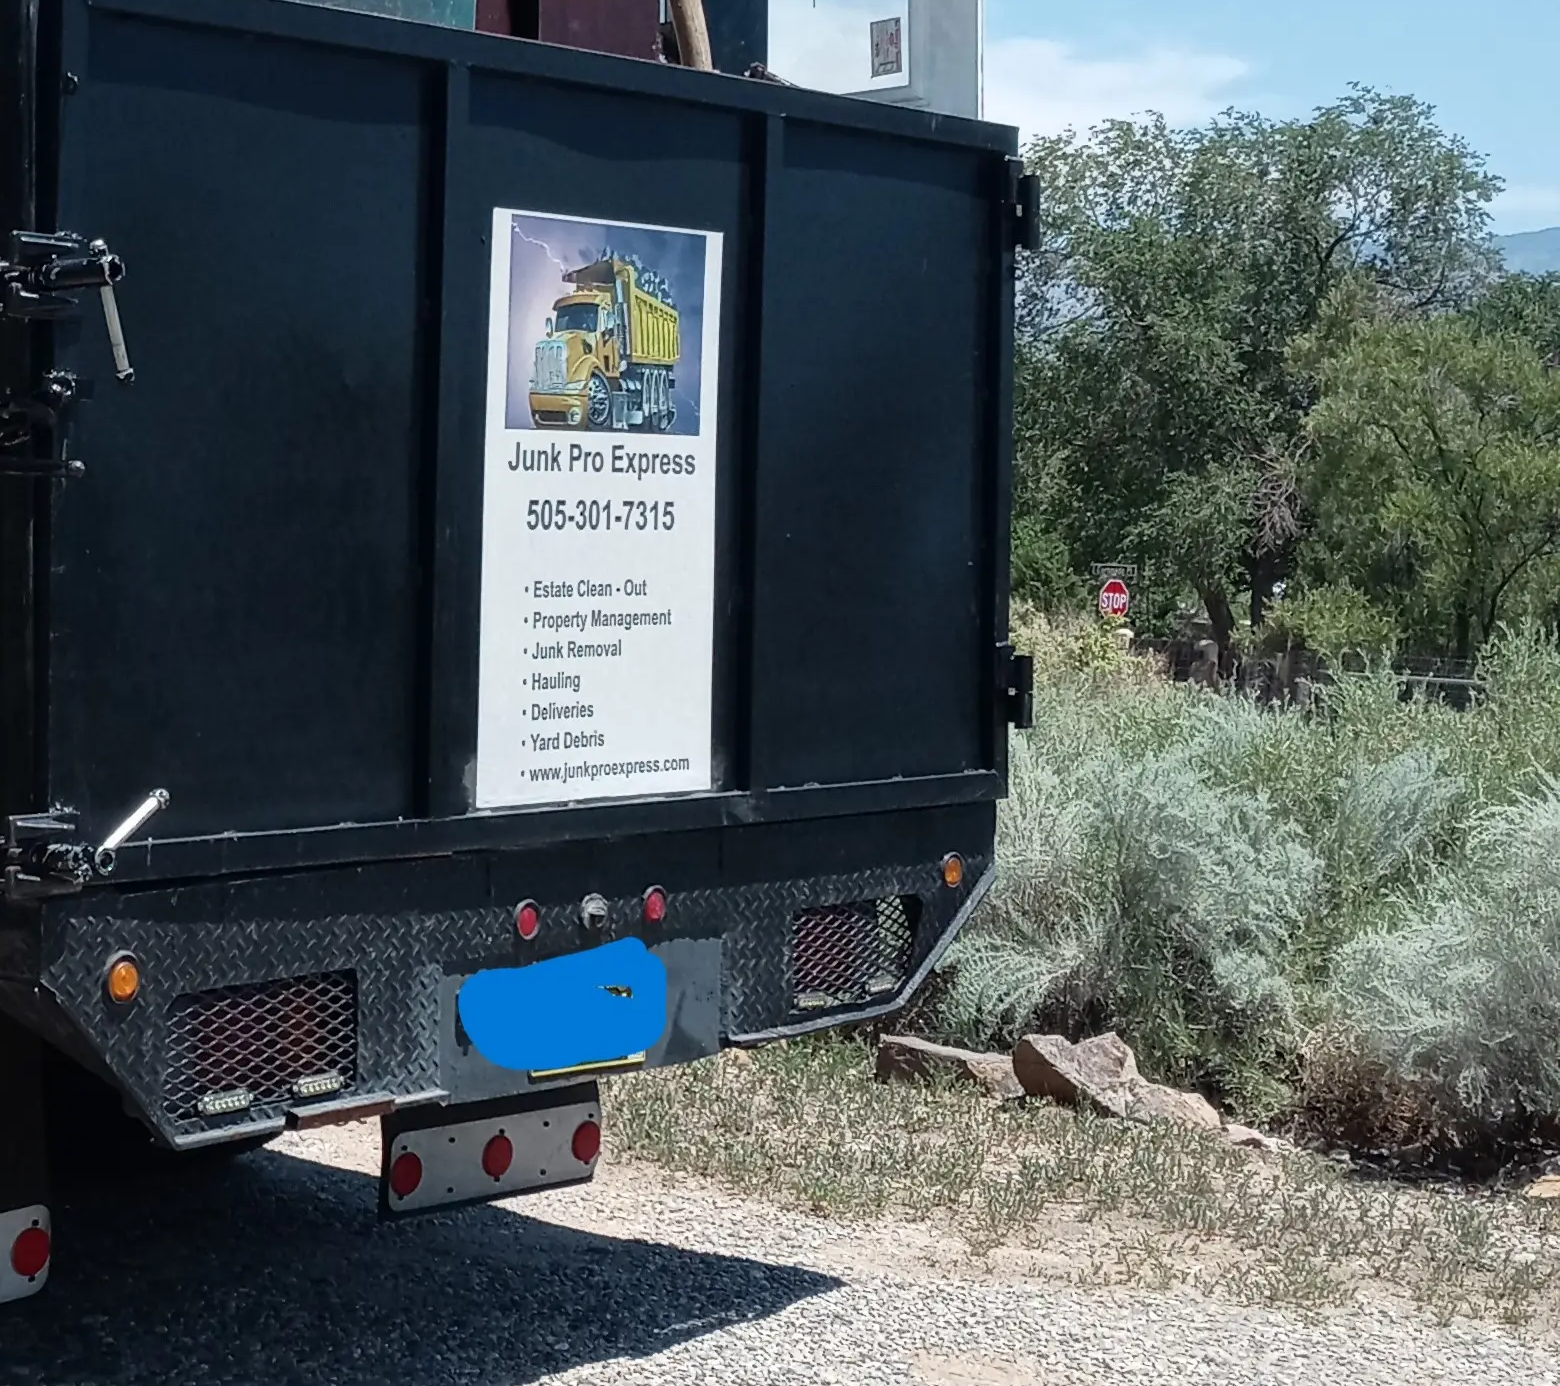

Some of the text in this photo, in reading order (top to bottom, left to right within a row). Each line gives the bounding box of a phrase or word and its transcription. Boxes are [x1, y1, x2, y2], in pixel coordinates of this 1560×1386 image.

[507, 441, 696, 481] Junk Pro Express
[526, 499, 675, 531] 505-301-7315
[533, 580, 574, 599] Estate
[576, 579, 613, 598] Clean
[623, 578, 647, 597] Out
[1101, 592, 1127, 609] STOP
[532, 608, 672, 633] Property Management
[531, 638, 622, 660] Junk Removal
[531, 671, 581, 693] Hauling
[531, 701, 594, 721] Deliveries
[530, 730, 605, 752] Yard Debris
[529, 758, 690, 784] www.junkproexpress.com
